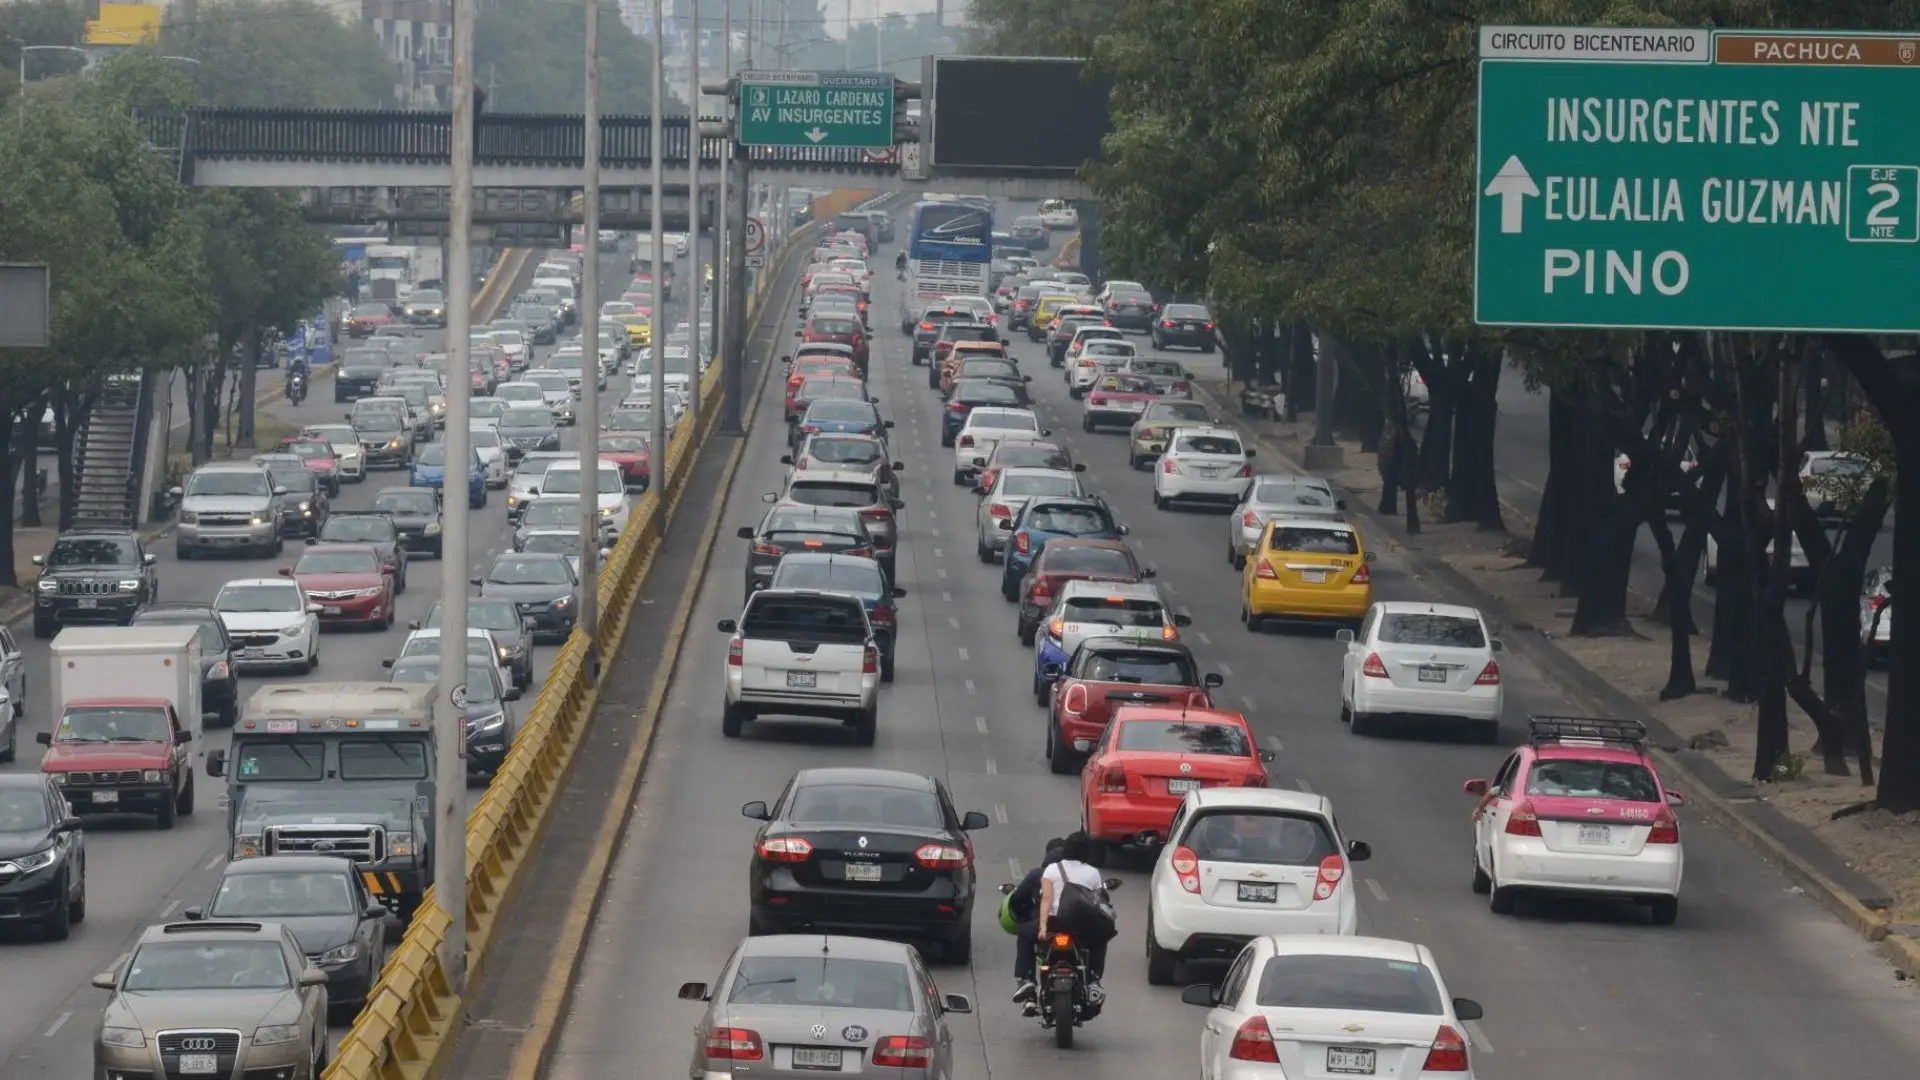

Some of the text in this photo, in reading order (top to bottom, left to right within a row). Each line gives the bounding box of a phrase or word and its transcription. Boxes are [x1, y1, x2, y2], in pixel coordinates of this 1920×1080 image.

[1491, 33, 1695, 52] CIRCUITO BICENTENARIO
[1754, 42, 1861, 60] PACHUCA
[823, 77, 878, 86] QUERETARO
[776, 89, 885, 107] LAZARO CARDENAS
[751, 107, 882, 125] AV INSURGENTES
[1547, 97, 1860, 146] INSURGENTES NTE
[1871, 168, 1898, 181] EJE
[1545, 175, 1841, 225] EULALIA GUZMAN
[1866, 183, 1900, 225] 2
[1870, 226, 1895, 238] NTE
[1543, 249, 1690, 296] PINO
